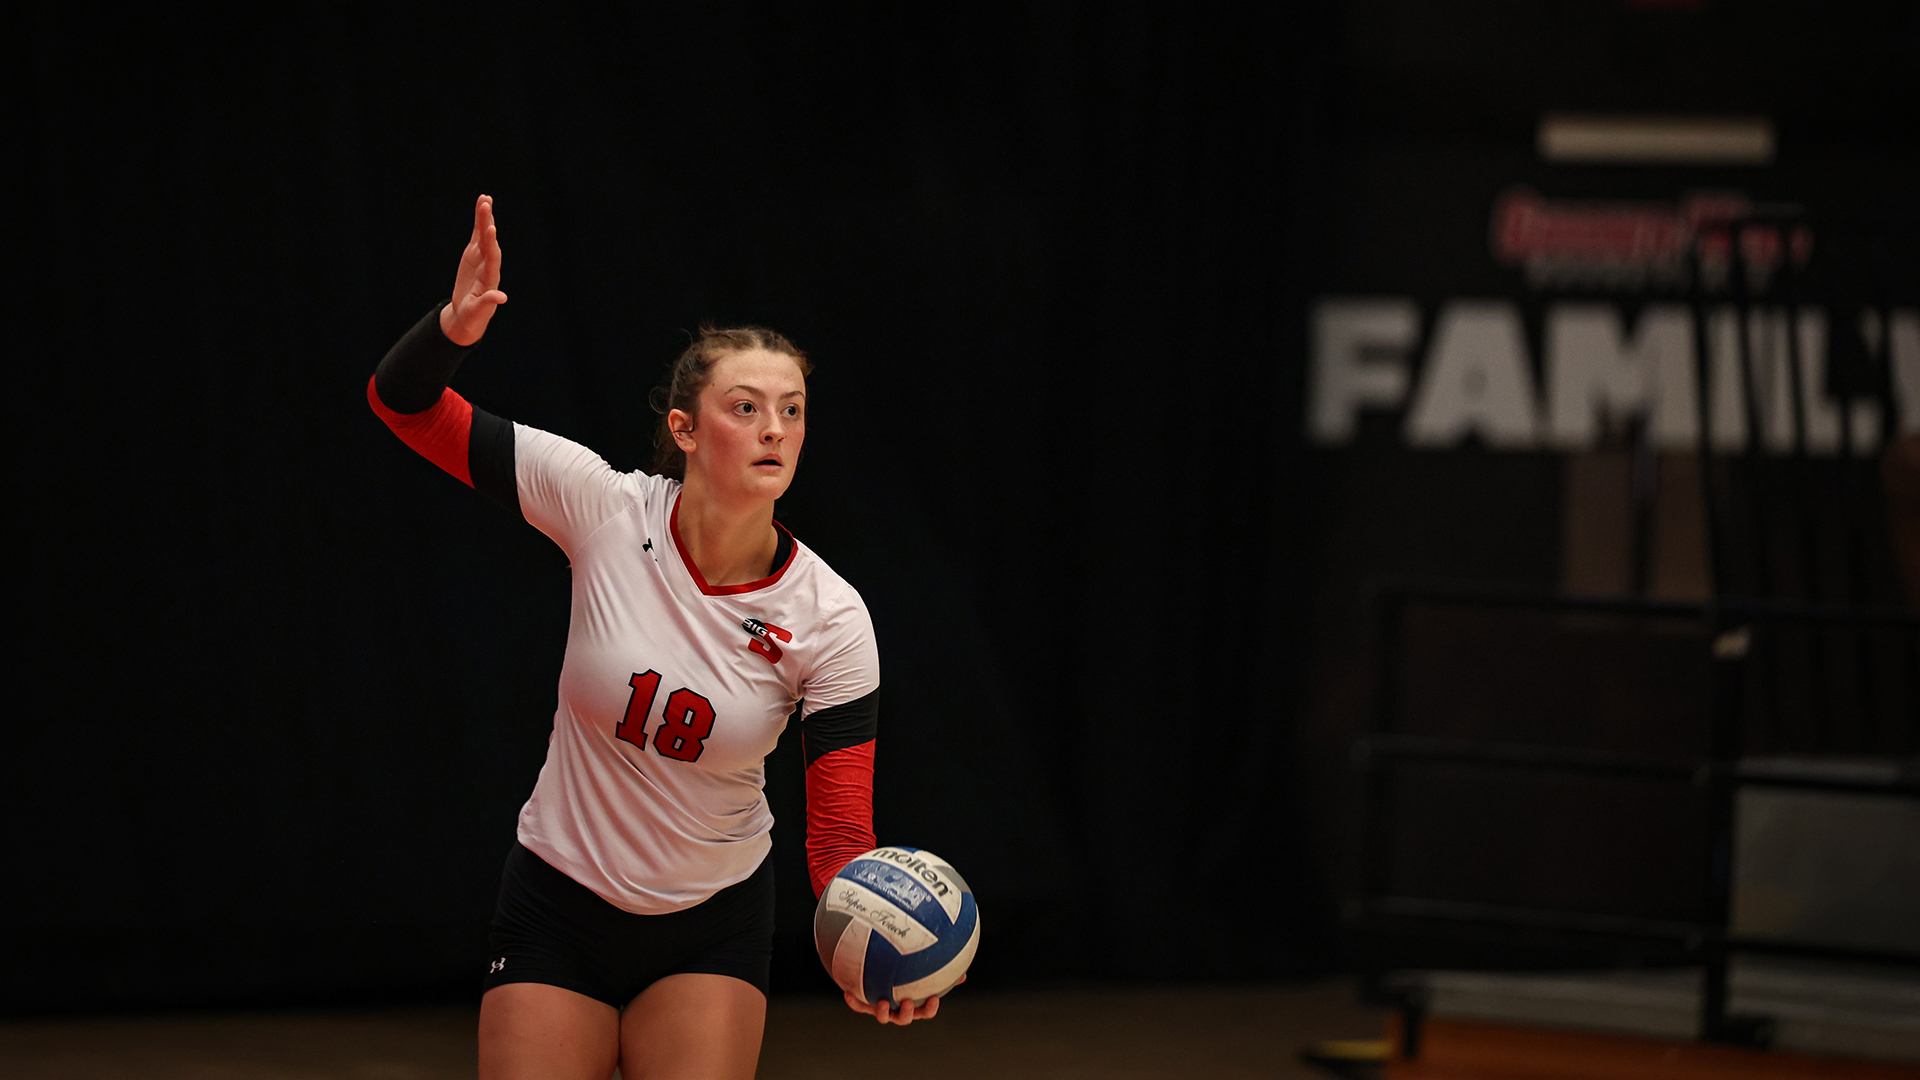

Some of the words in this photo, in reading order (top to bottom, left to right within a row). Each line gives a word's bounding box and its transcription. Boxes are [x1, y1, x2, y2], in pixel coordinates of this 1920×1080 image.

[615, 668, 717, 763] 18
[873, 850, 948, 897] molten
[839, 888, 868, 910] Super
[870, 910, 911, 938] Touch
